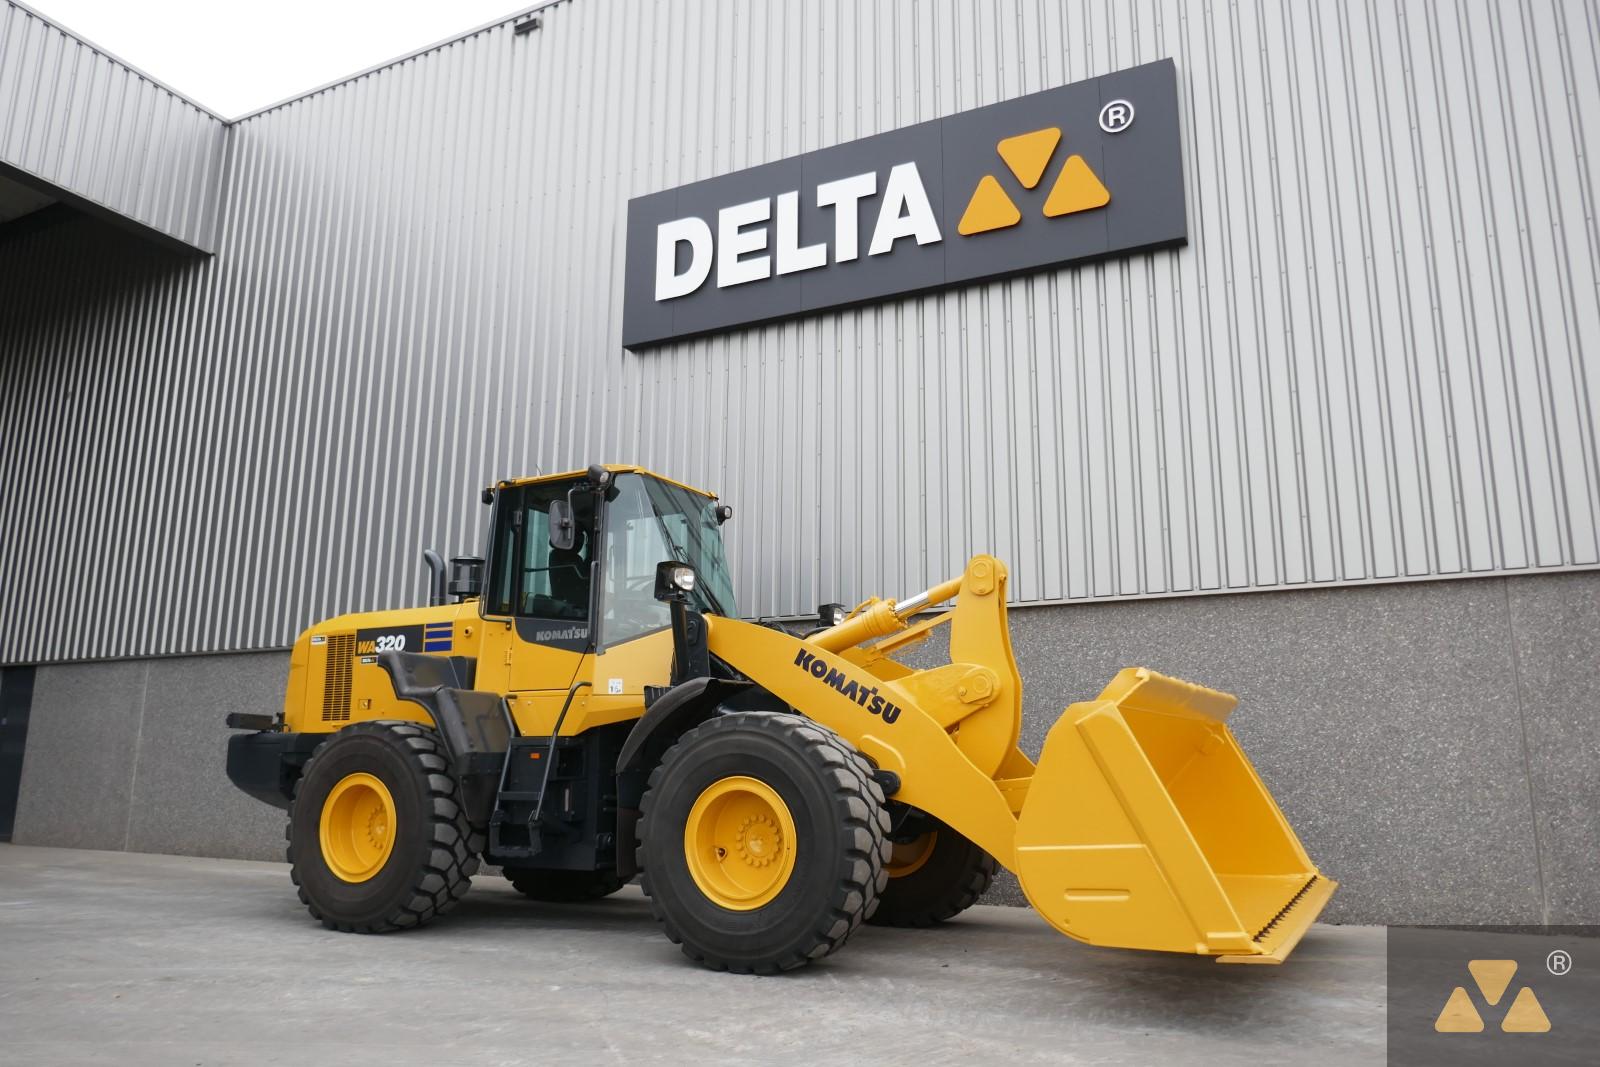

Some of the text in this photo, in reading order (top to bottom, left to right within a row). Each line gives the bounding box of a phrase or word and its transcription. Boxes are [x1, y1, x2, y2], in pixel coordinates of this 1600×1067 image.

[655, 161, 942, 302] DELTA
[358, 634, 406, 654] WA320
[536, 626, 588, 641] KOMATSU
[794, 648, 902, 724] KOMATSU
